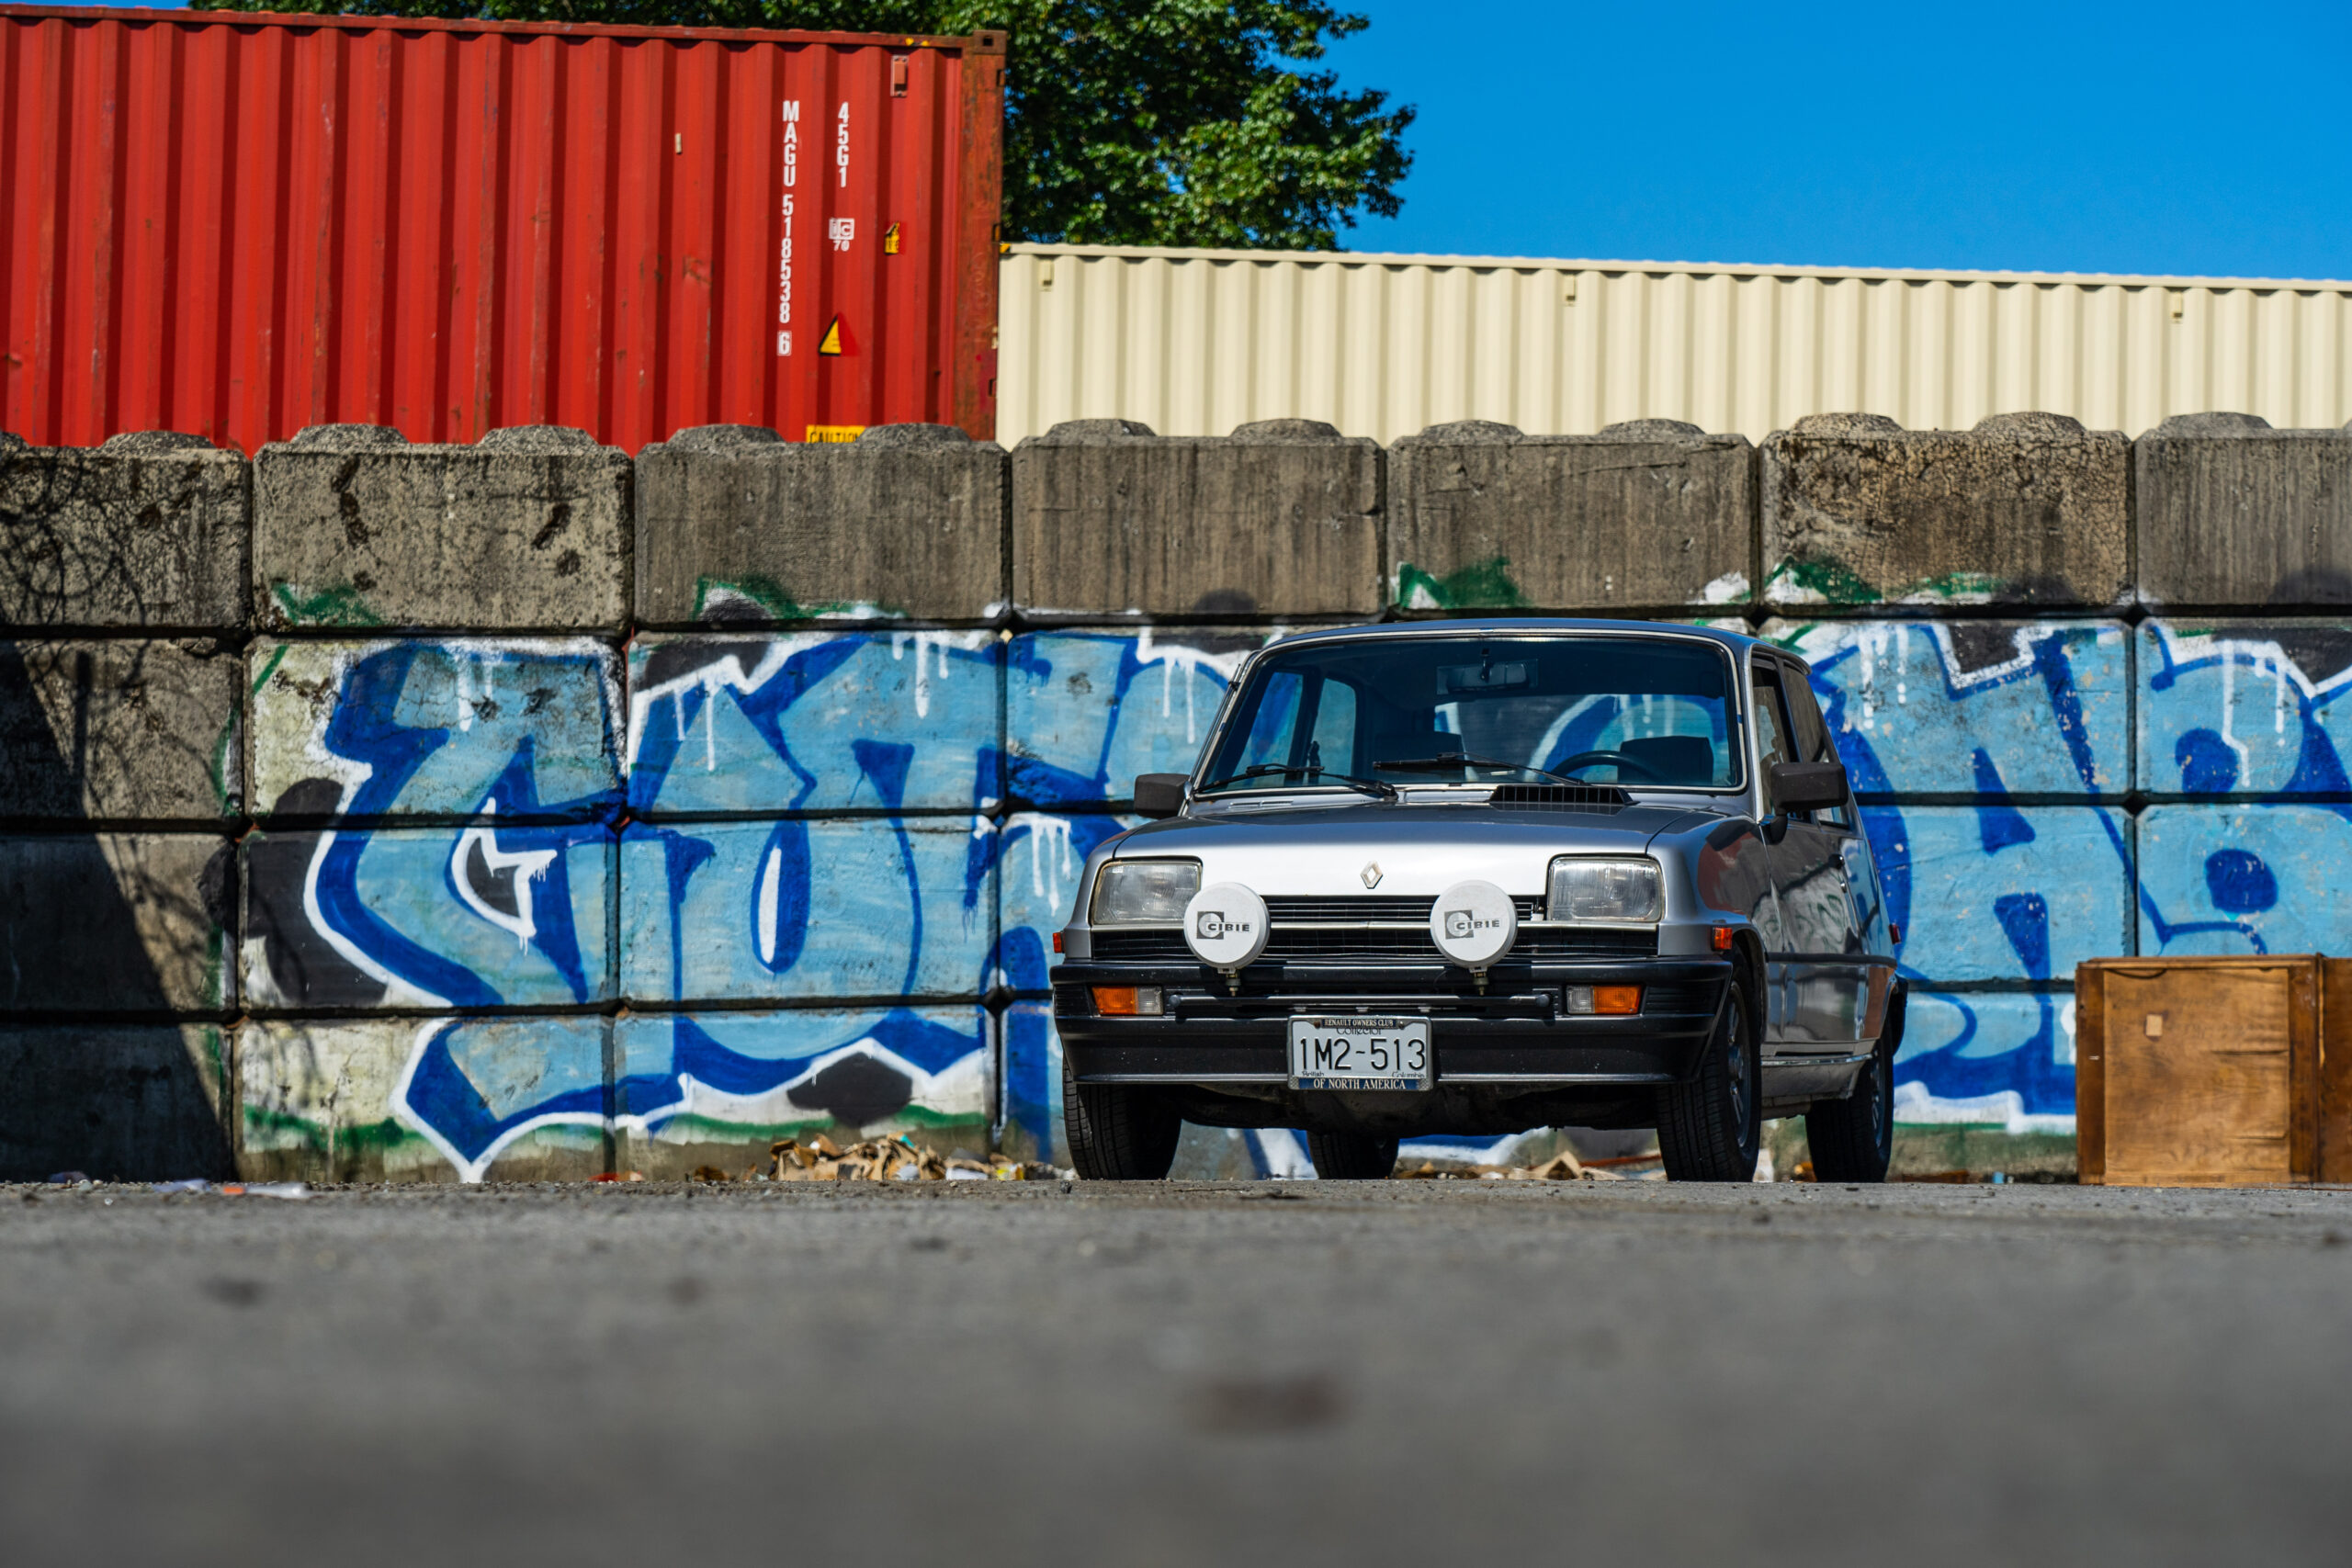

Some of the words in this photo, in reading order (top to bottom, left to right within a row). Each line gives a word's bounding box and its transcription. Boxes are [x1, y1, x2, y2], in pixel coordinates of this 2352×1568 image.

[782, 100, 800, 187] MAGU
[836, 101, 850, 188] 45G1
[833, 240, 850, 252] 70
[779, 193, 795, 323] 518538
[778, 332, 791, 355] 6
[1207, 922, 1250, 932] CIBIE
[1455, 919, 1500, 931] CIBIE
[1324, 1019, 1351, 1027] RENAULT
[1352, 1019, 1377, 1027] OWNERS
[1300, 1038, 1426, 1071] 1M2-513
[1313, 1078, 1326, 1089] OF
[1329, 1078, 1360, 1090] NORTH
[1363, 1079, 1407, 1090] AMERICA
